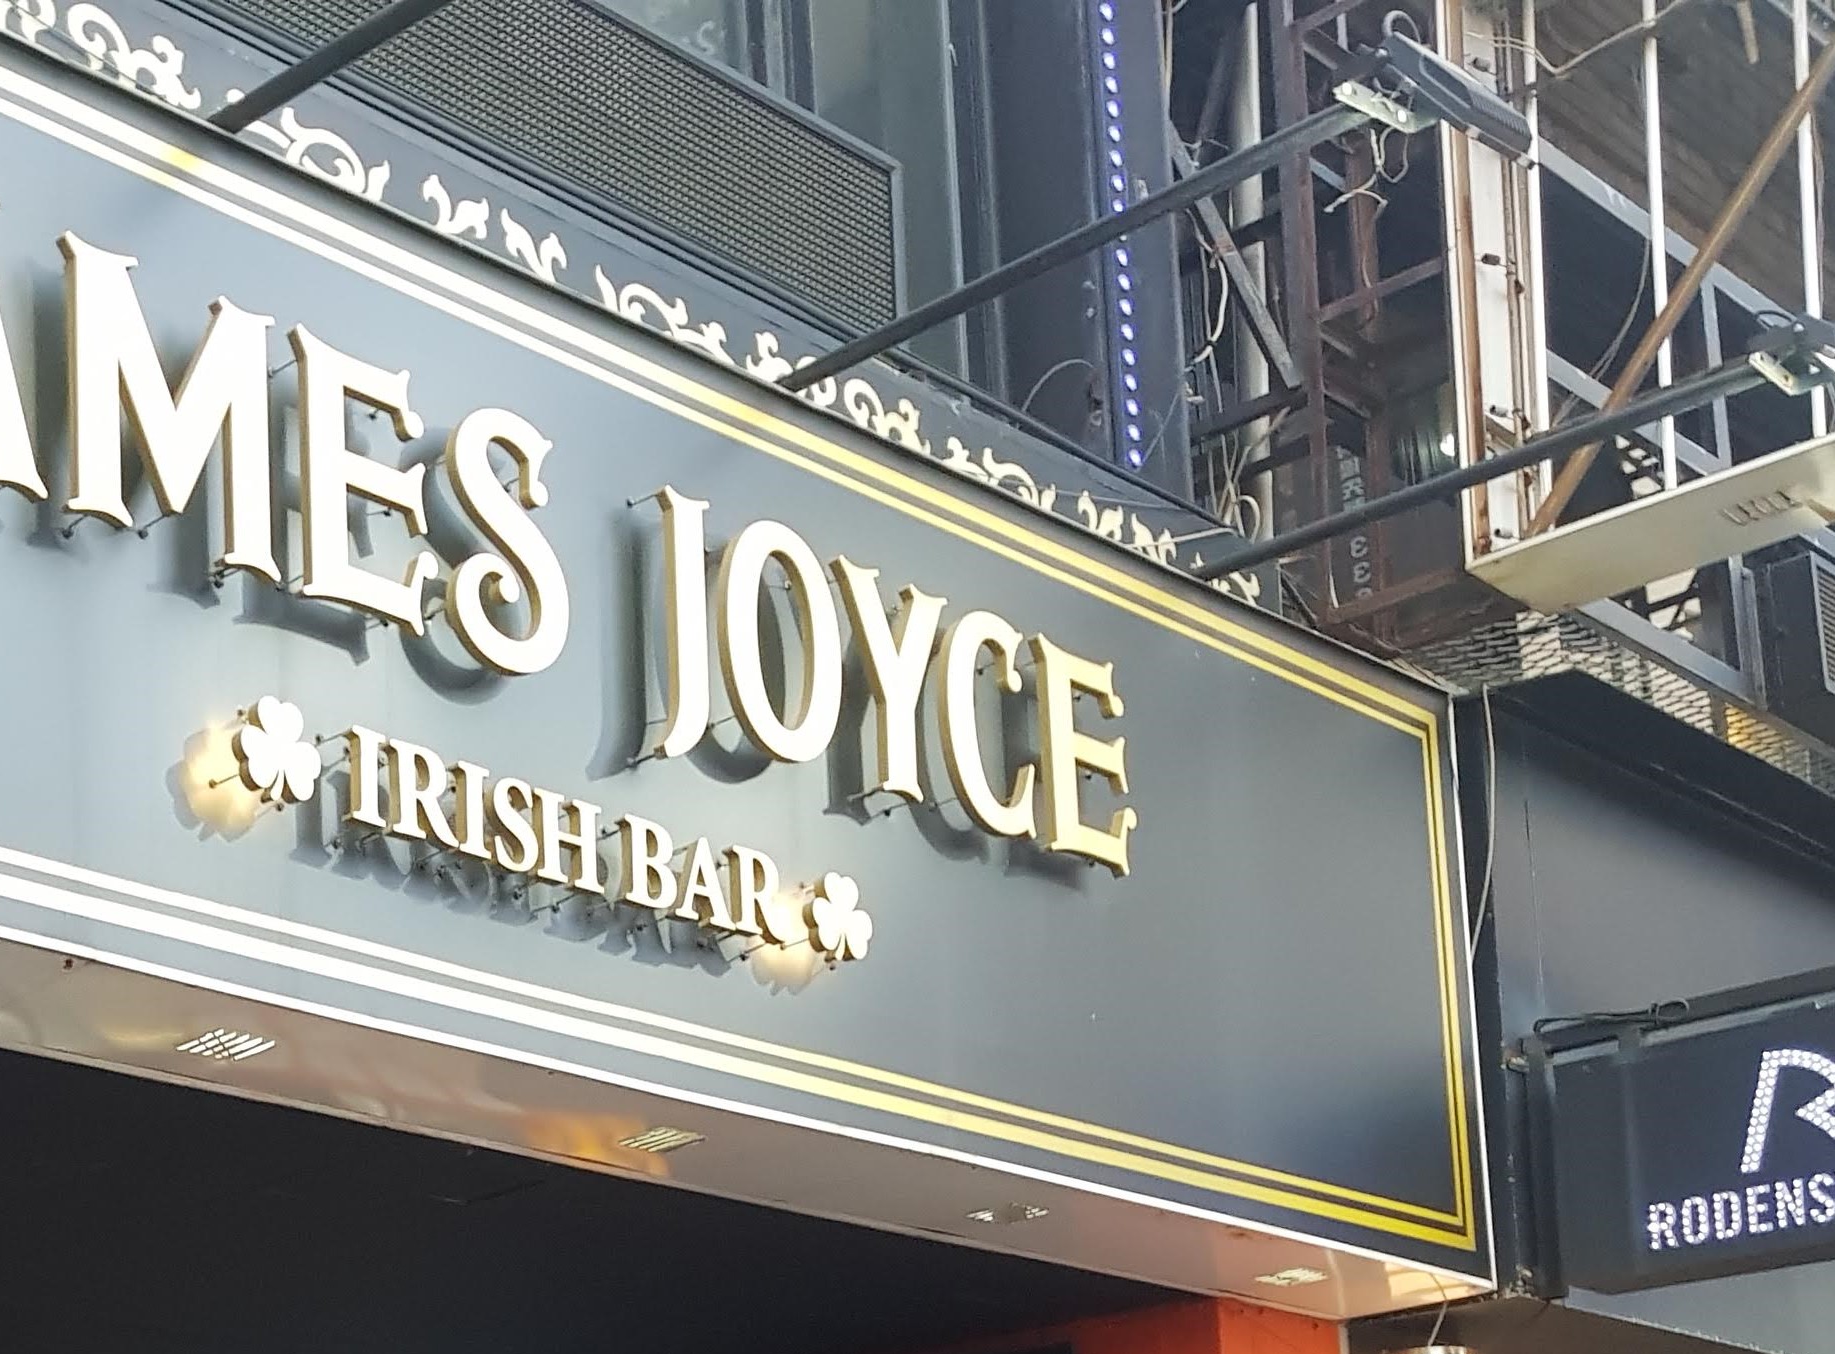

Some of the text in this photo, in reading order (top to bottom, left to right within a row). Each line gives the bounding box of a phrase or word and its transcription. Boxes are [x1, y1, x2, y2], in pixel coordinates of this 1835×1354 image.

[652, 484, 1138, 880] JOYCE
[346, 724, 787, 946] IRISH BAR
[1647, 1173, 1835, 1250] RODENS
